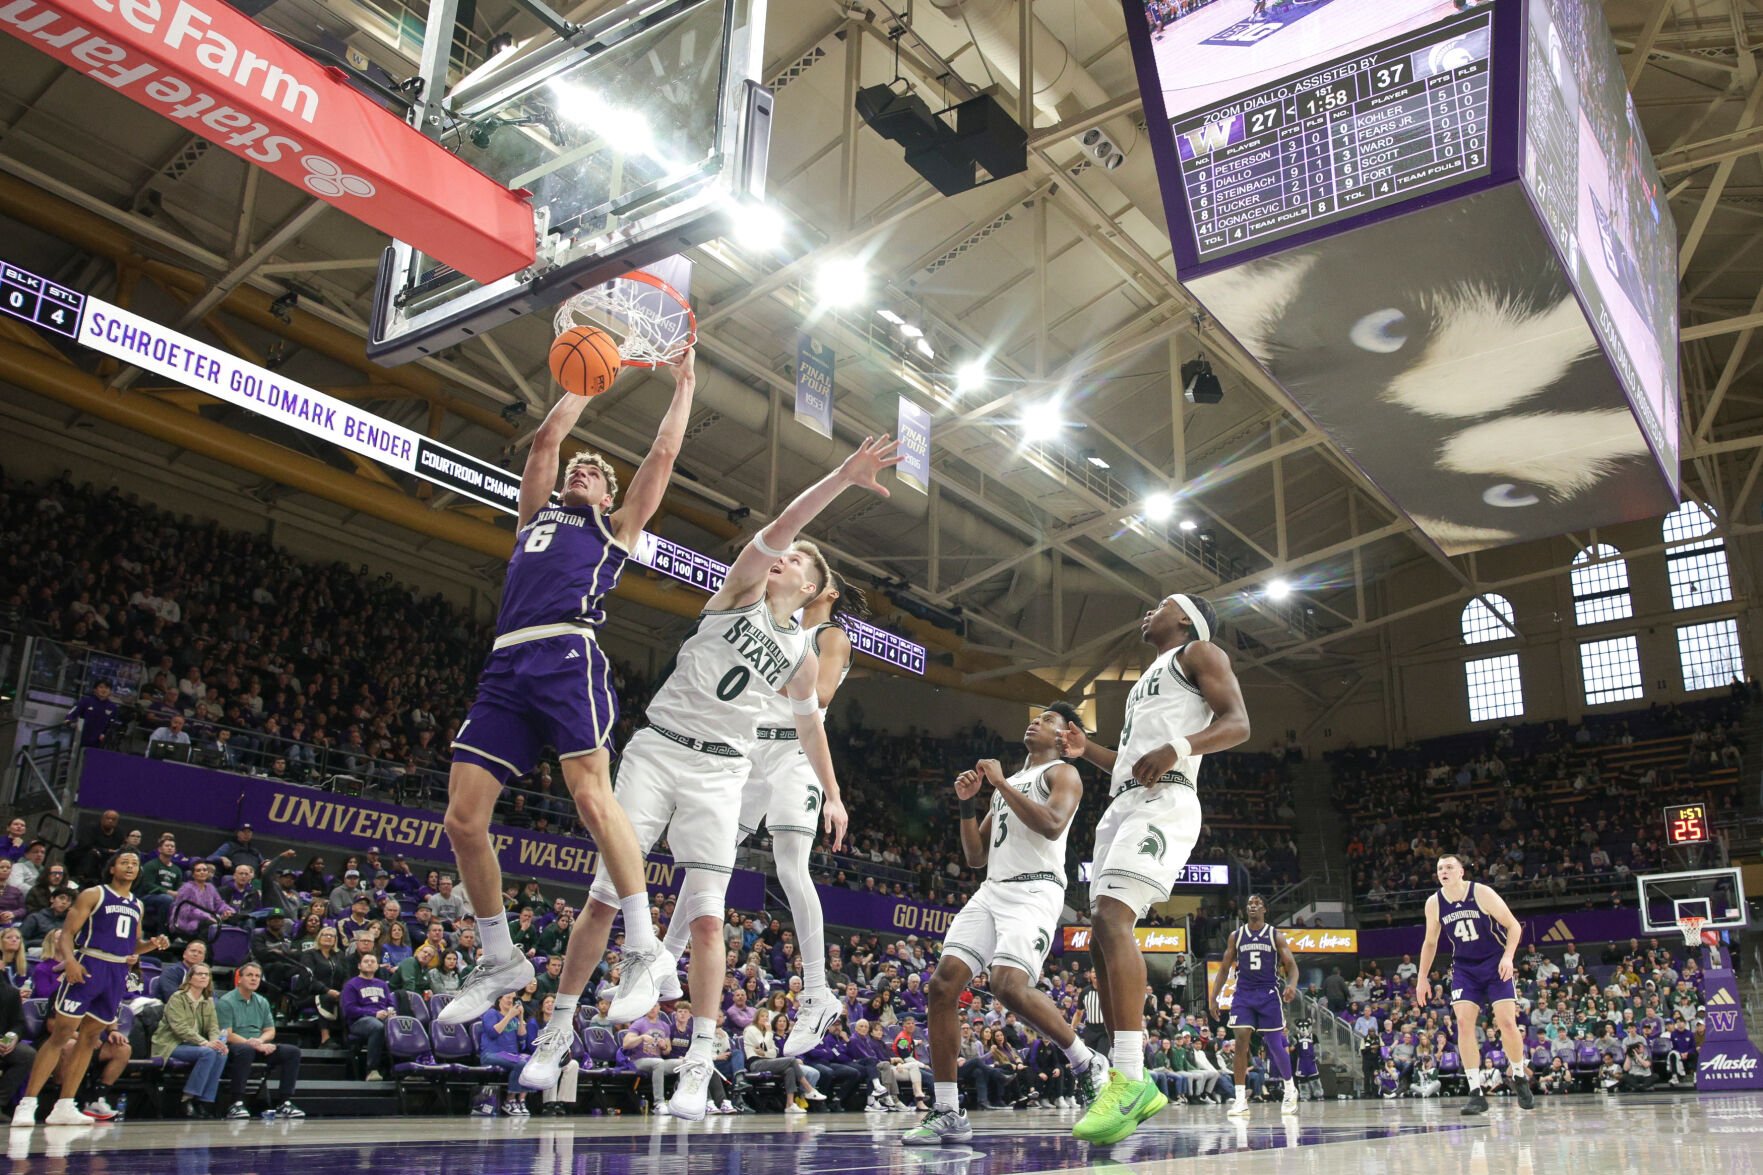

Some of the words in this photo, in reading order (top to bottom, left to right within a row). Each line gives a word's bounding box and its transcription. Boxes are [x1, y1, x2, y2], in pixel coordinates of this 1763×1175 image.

[1203, 105, 1240, 126] ZOOM
[1294, 64, 1357, 93] ASSISTED
[1361, 55, 1378, 70] BY
[1315, 86, 1332, 97] 1ST
[1333, 111, 1350, 119] NO.
[1371, 89, 1408, 106] PLAYER
[1429, 74, 1450, 86] PTS
[1458, 65, 1477, 76] FLS
[1376, 63, 1404, 88] 37
[1306, 89, 1347, 115] 1:58
[1340, 123, 1347, 133] 0
[1357, 105, 1403, 127] KOHLER
[1438, 90, 1446, 101] 5
[1462, 82, 1470, 93] 0
[1184, 116, 1236, 157] W
[1226, 139, 1261, 155] PLAYER
[1281, 126, 1300, 136] PTS
[1306, 117, 1324, 127] FLS
[1251, 109, 1277, 132] 27
[1342, 136, 1349, 145] 1
[1358, 121, 1397, 140] FEARS
[1398, 115, 1415, 128] JR.
[1439, 103, 1448, 114] 5
[1464, 95, 1472, 106] 0
[1343, 150, 1350, 160] 3
[1360, 136, 1394, 154] WARD
[1441, 117, 1449, 128] 0
[1466, 109, 1474, 120] 0
[1199, 171, 1206, 181] 0
[1215, 150, 1271, 175] PETERSON
[1288, 140, 1296, 151] 3
[1312, 133, 1320, 143] 0
[1344, 163, 1351, 173] 6
[1362, 148, 1399, 168] SCOTT
[1443, 131, 1451, 142] 2
[1468, 123, 1476, 134] 0
[1345, 178, 1352, 188] 9
[1362, 165, 1393, 183] FORT
[1445, 146, 1453, 156] 0
[1470, 138, 1478, 149] 0
[1200, 184, 1207, 193] 5
[1215, 169, 1251, 188] DIALLO
[1290, 154, 1297, 164] 7
[1315, 145, 1321, 155] 1
[1200, 198, 1207, 207] 6
[1216, 175, 1275, 202] STEINBACH
[1290, 167, 1298, 178] 9
[1316, 160, 1322, 169] 1
[1344, 191, 1365, 201] TOL
[1380, 182, 1389, 193] 4
[1397, 170, 1426, 184] TEAM
[1428, 160, 1461, 174] FOULS
[1470, 154, 1479, 165] 3
[1200, 222, 1212, 234] 41
[1218, 202, 1280, 229] OGNACEVIC
[1293, 194, 1300, 205] 0
[1318, 187, 1324, 197] 1
[1201, 211, 1208, 220] 8
[1217, 194, 1261, 215] TUCKER
[1292, 181, 1299, 192] 2
[1315, 172, 1323, 183] 0
[1204, 236, 1223, 245] TOL
[1234, 228, 1242, 238] 4
[1250, 219, 1276, 231] TEAM
[1278, 208, 1308, 221] FOULS
[1318, 202, 1326, 212] 8
[5, 268, 40, 288] BLK
[49, 286, 78, 304] STL
[9, 291, 23, 308] 0
[51, 308, 64, 325] 4
[89, 312, 221, 385] SCHROETER
[230, 369, 336, 430] GOLDMARK
[343, 415, 412, 461] BENDER
[800, 361, 831, 387] FINAL
[800, 373, 830, 397] FOUR
[805, 392, 824, 411] 1953
[901, 423, 927, 447] FINAL
[902, 435, 925, 457] FOUR
[421, 450, 483, 487] COURTROOM
[484, 475, 520, 503] CHAMPI
[537, 511, 586, 528] HINGTON
[524, 523, 558, 553] 6
[657, 554, 669, 568] 46
[674, 561, 690, 577] 100
[696, 570, 704, 581] 9
[712, 576, 723, 589] 14
[722, 615, 790, 686] STATE
[749, 625, 783, 663] MICHIGAN
[848, 631, 858, 643] 33
[862, 637, 871, 649] 19
[877, 643, 883, 653] 7
[889, 649, 895, 658] 4
[902, 653, 908, 663] 0
[915, 659, 920, 668] 4
[716, 665, 750, 702] 0
[993, 813, 1009, 848] 3
[1674, 819, 1701, 840] 25
[1680, 807, 1702, 820] 1:57
[268, 793, 447, 849] UNIVERSIT
[519, 838, 675, 888] WASHION
[1192, 872, 1198, 881] 3
[1202, 872, 1209, 882] 4
[116, 914, 131, 939] 0
[893, 903, 918, 929] GO
[1442, 909, 1480, 925] WASHINGTON
[1454, 919, 1480, 942] 41
[1249, 951, 1261, 970] 5
[63, 999, 82, 1013] W
[1708, 1010, 1738, 1032] W
[1700, 1053, 1756, 1071] Alaska
[1705, 1072, 1754, 1081] AIRLINES
